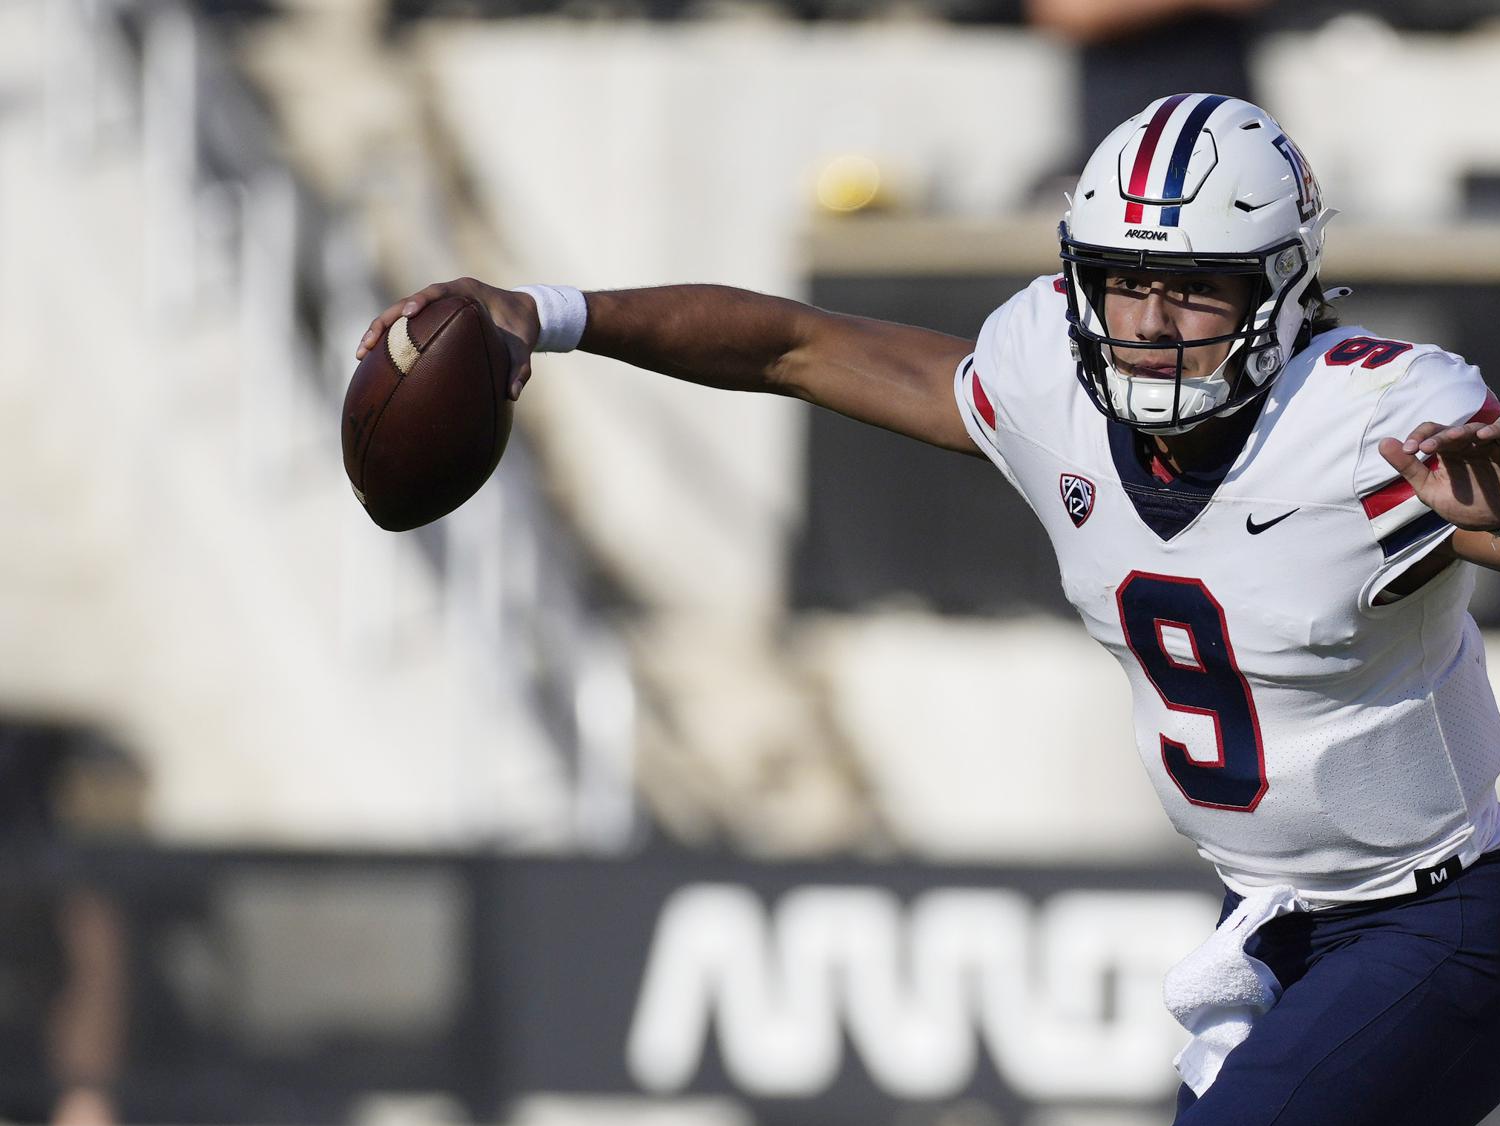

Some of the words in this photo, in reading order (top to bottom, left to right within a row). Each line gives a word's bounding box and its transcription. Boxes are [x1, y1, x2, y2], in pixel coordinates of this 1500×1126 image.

[1125, 229, 1168, 241] ARIZONA
[1062, 475, 1092, 511] PAC
[1069, 496, 1085, 517] 12
[1116, 570, 1269, 812] 9
[1430, 867, 1448, 885] M
